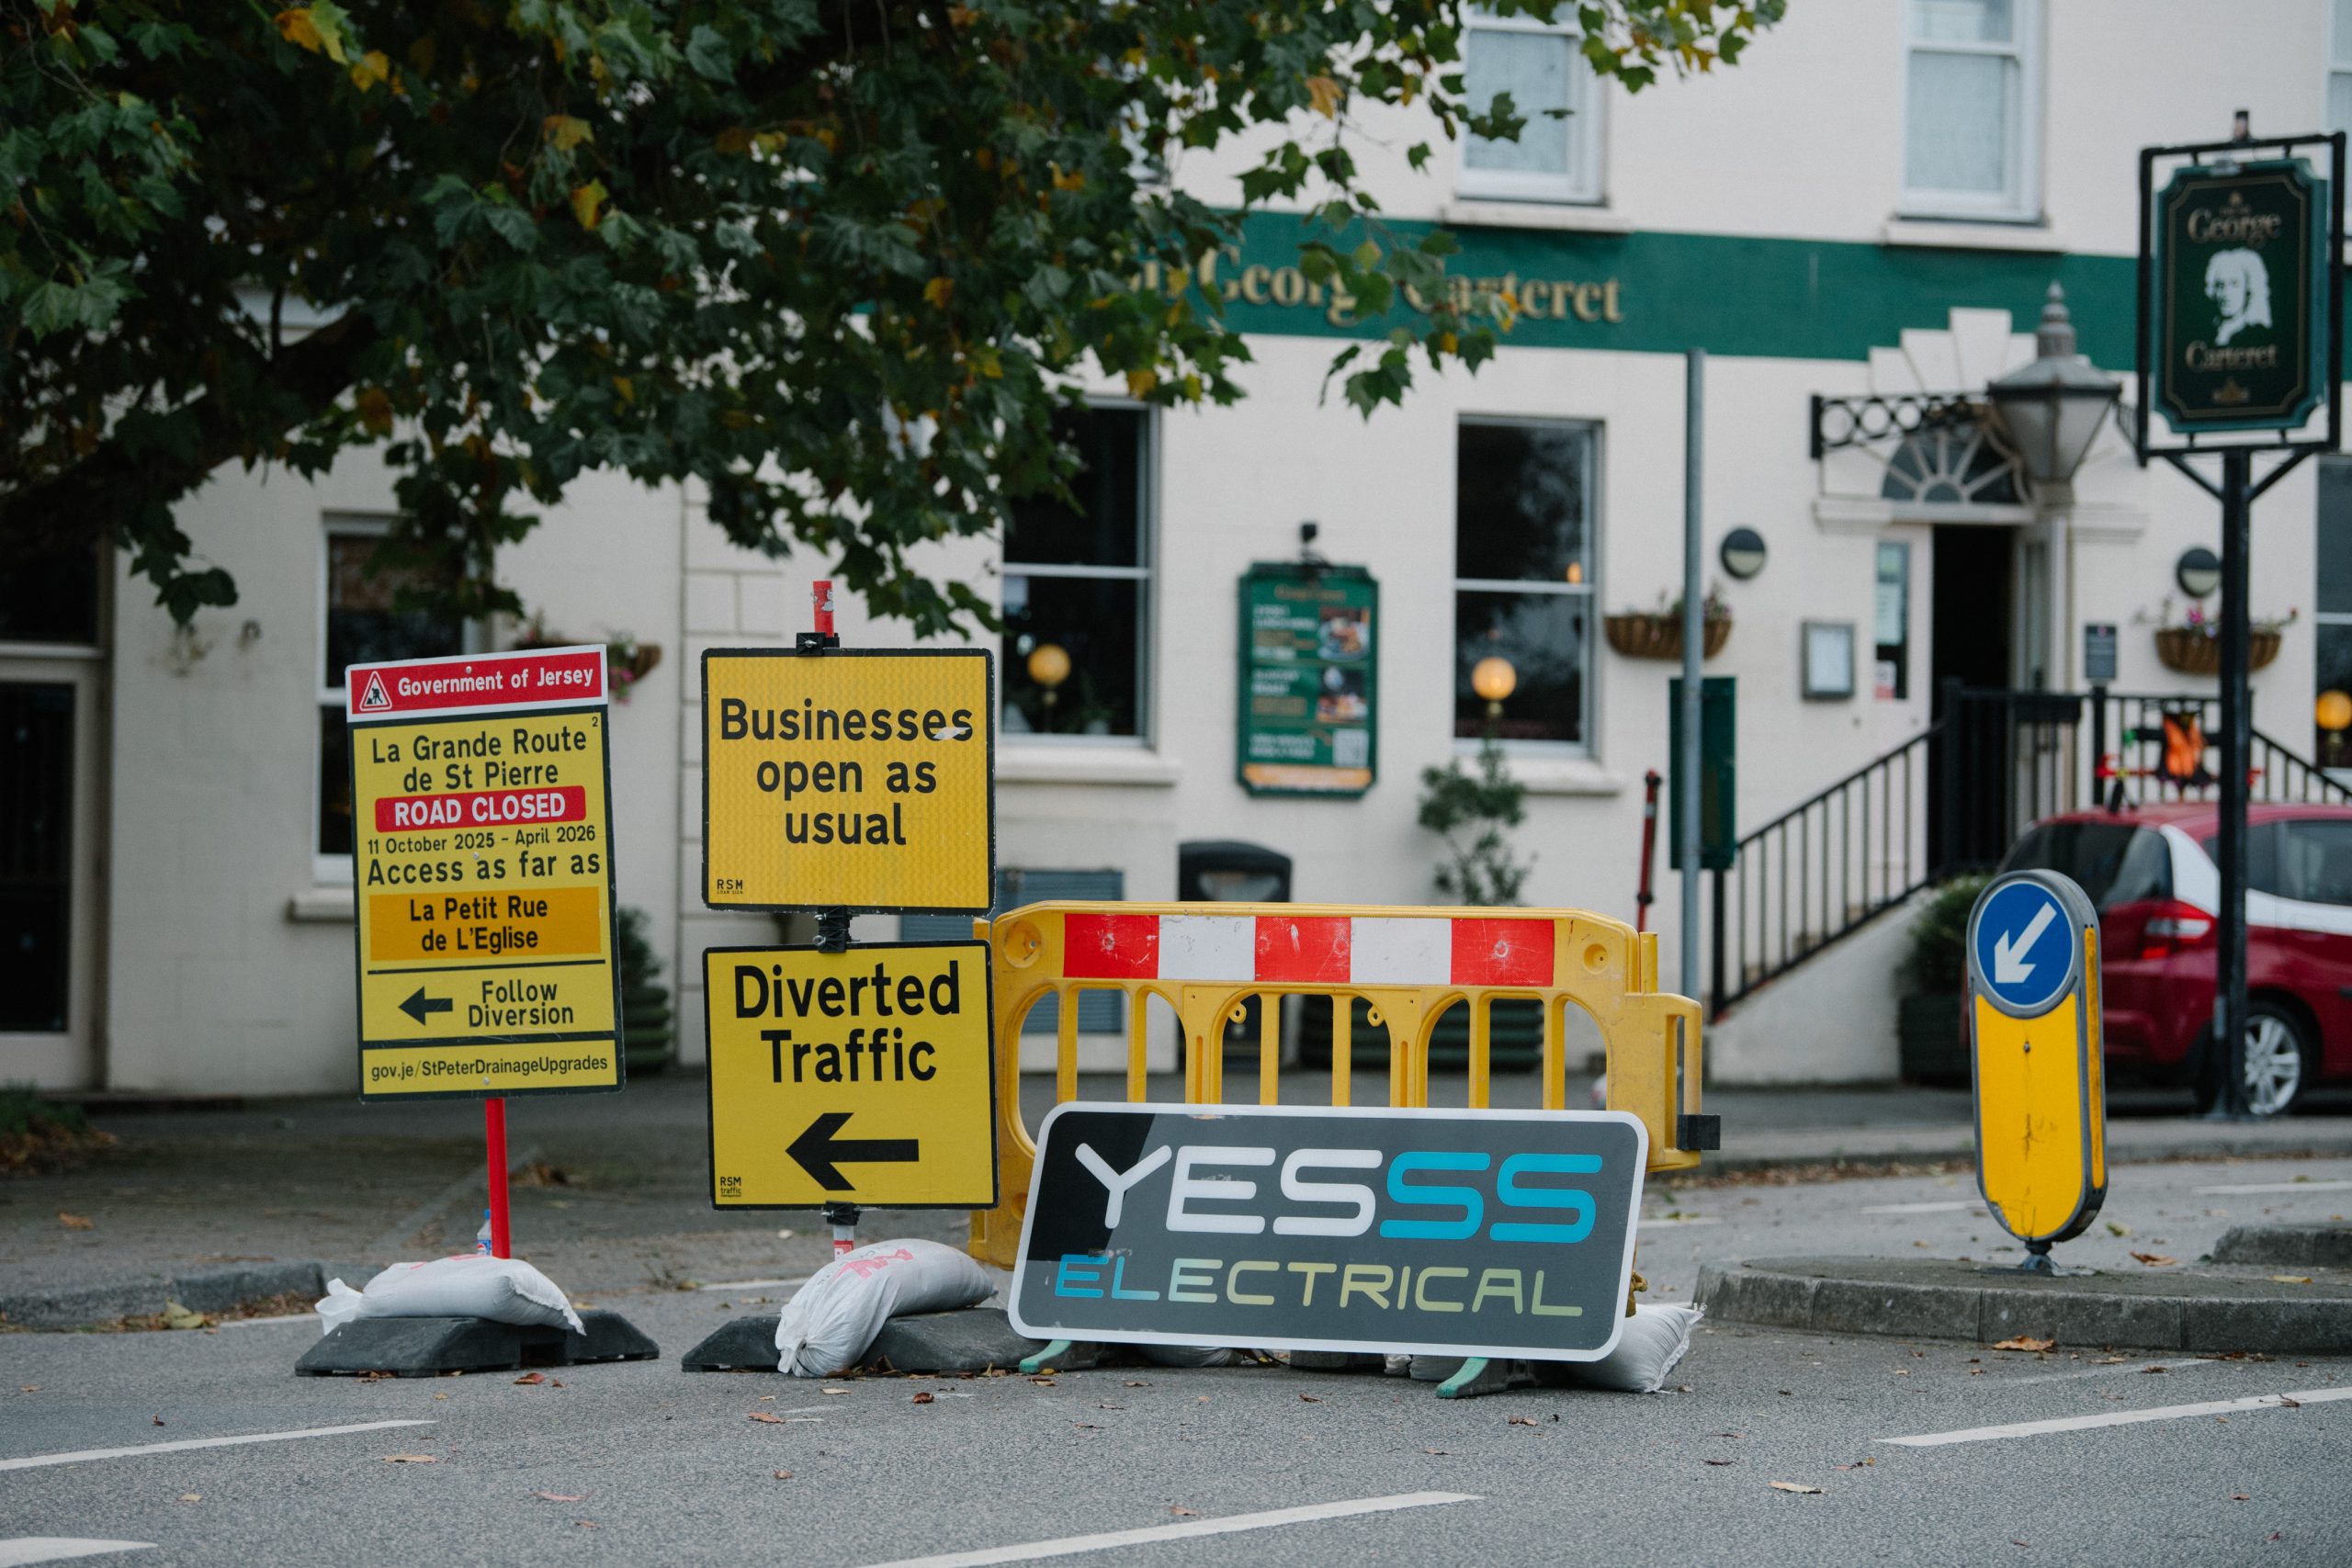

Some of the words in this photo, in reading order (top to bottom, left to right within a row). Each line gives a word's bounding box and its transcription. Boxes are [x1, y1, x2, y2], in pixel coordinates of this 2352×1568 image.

[398, 671, 503, 697] Government
[511, 669, 528, 688] of
[537, 667, 594, 687] Jersey
[592, 716, 598, 727] 2
[720, 698, 974, 741] Businesses
[372, 738, 401, 763] La
[413, 730, 502, 761] Grande
[513, 726, 587, 754] Route
[403, 767, 432, 792] de
[446, 763, 473, 789] St
[485, 761, 559, 787] Pierre
[756, 761, 863, 801] open
[886, 761, 937, 794] as
[394, 799, 461, 826] ROAD
[471, 793, 566, 821] CLOSED
[786, 802, 907, 846] usual
[368, 839, 379, 854] 11
[385, 835, 447, 853] October
[455, 832, 495, 850] 2025
[515, 828, 549, 849] April
[556, 825, 595, 843] 2026
[368, 858, 463, 886] Access
[477, 858, 506, 880] as
[519, 851, 557, 877] far
[570, 852, 601, 874] as
[717, 879, 743, 890] RSM
[410, 899, 435, 921] La
[445, 897, 498, 920] Petit
[508, 896, 548, 918] Rue
[422, 930, 447, 952] de
[457, 926, 538, 954] L'Eglise
[482, 979, 558, 1003] Follow
[734, 960, 960, 1019] Diverted
[469, 1002, 574, 1028] Diversion
[371, 1055, 608, 1081] gov.je/StPeterDrainageUpgrades
[761, 1027, 937, 1083] Traffic
[720, 1176, 741, 1186] RSM
[1074, 1142, 1603, 1244] YESSS
[1055, 1253, 1583, 1317] ELECTRICAL
